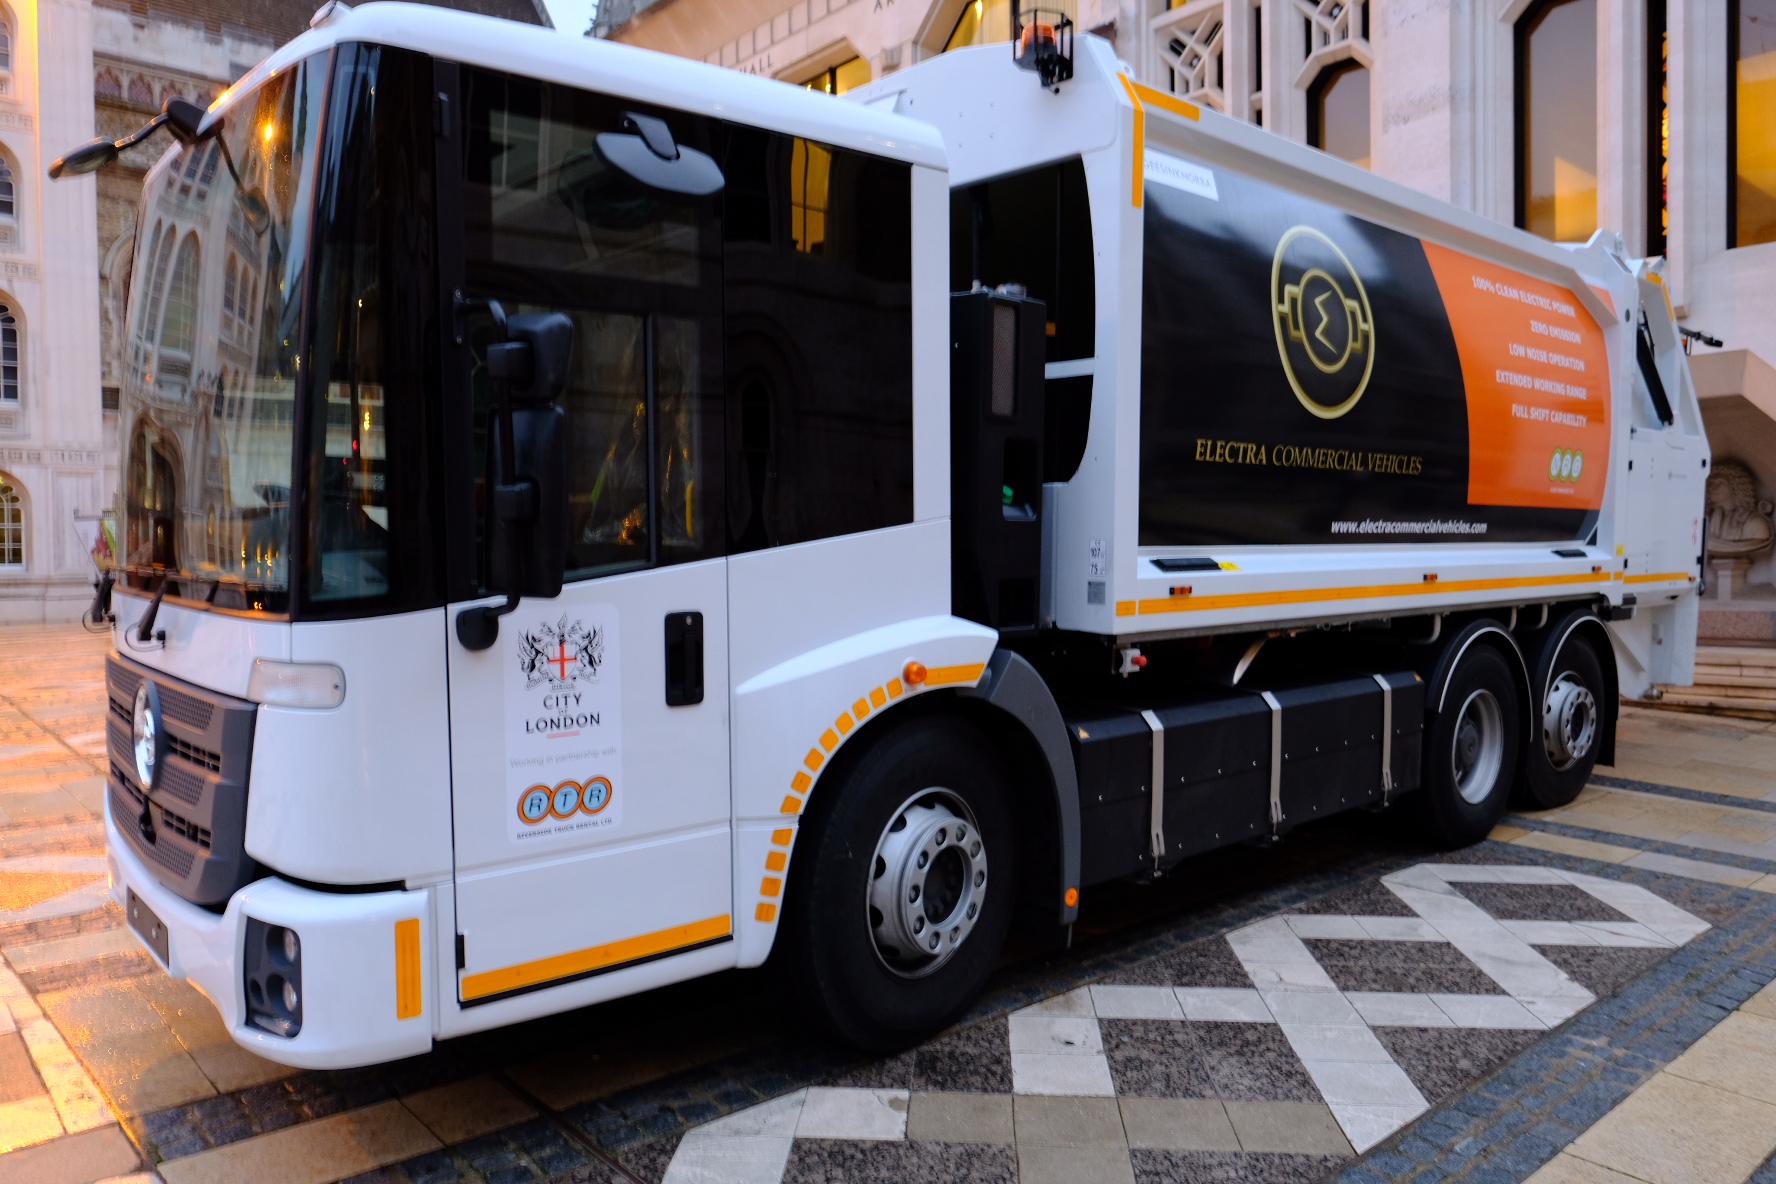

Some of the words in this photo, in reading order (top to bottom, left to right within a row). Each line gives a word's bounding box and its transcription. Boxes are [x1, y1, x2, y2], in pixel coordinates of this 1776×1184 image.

[1472, 275, 1495, 294] 100%
[1495, 282, 1520, 301] CLEAN
[1519, 290, 1552, 311] ELECTRIC
[1551, 300, 1576, 318] POWER
[1529, 319, 1549, 336] ZERO
[1549, 324, 1582, 344] EMISSION
[1508, 342, 1526, 358] LOW
[1526, 347, 1549, 364] NOISE
[1549, 351, 1586, 372] OPERATION
[1495, 369, 1533, 389] EXTENDED
[1533, 377, 1567, 396] WORKING
[1566, 385, 1587, 400] RANGE
[1512, 403, 1529, 419] FULL
[1529, 406, 1550, 422] SHIFT
[1550, 410, 1588, 428] CAPABILITY
[1195, 438, 1268, 465] ELECTRA
[1272, 444, 1364, 472] COMMERCIAL
[1366, 452, 1423, 475] VEHICLES
[1331, 518, 1488, 534] www.electracommercialvehicles.com
[543, 692, 583, 710] CITY
[525, 711, 601, 735] LONDON
[510, 757, 544, 768] Working
[546, 755, 554, 765] in
[556, 749, 600, 763] partnership
[601, 746, 617, 757] with
[516, 826, 552, 840] RIVERSIDE
[554, 822, 576, 834] TRUCK
[575, 818, 599, 831] RENTAL
[600, 816, 612, 827] LTD
